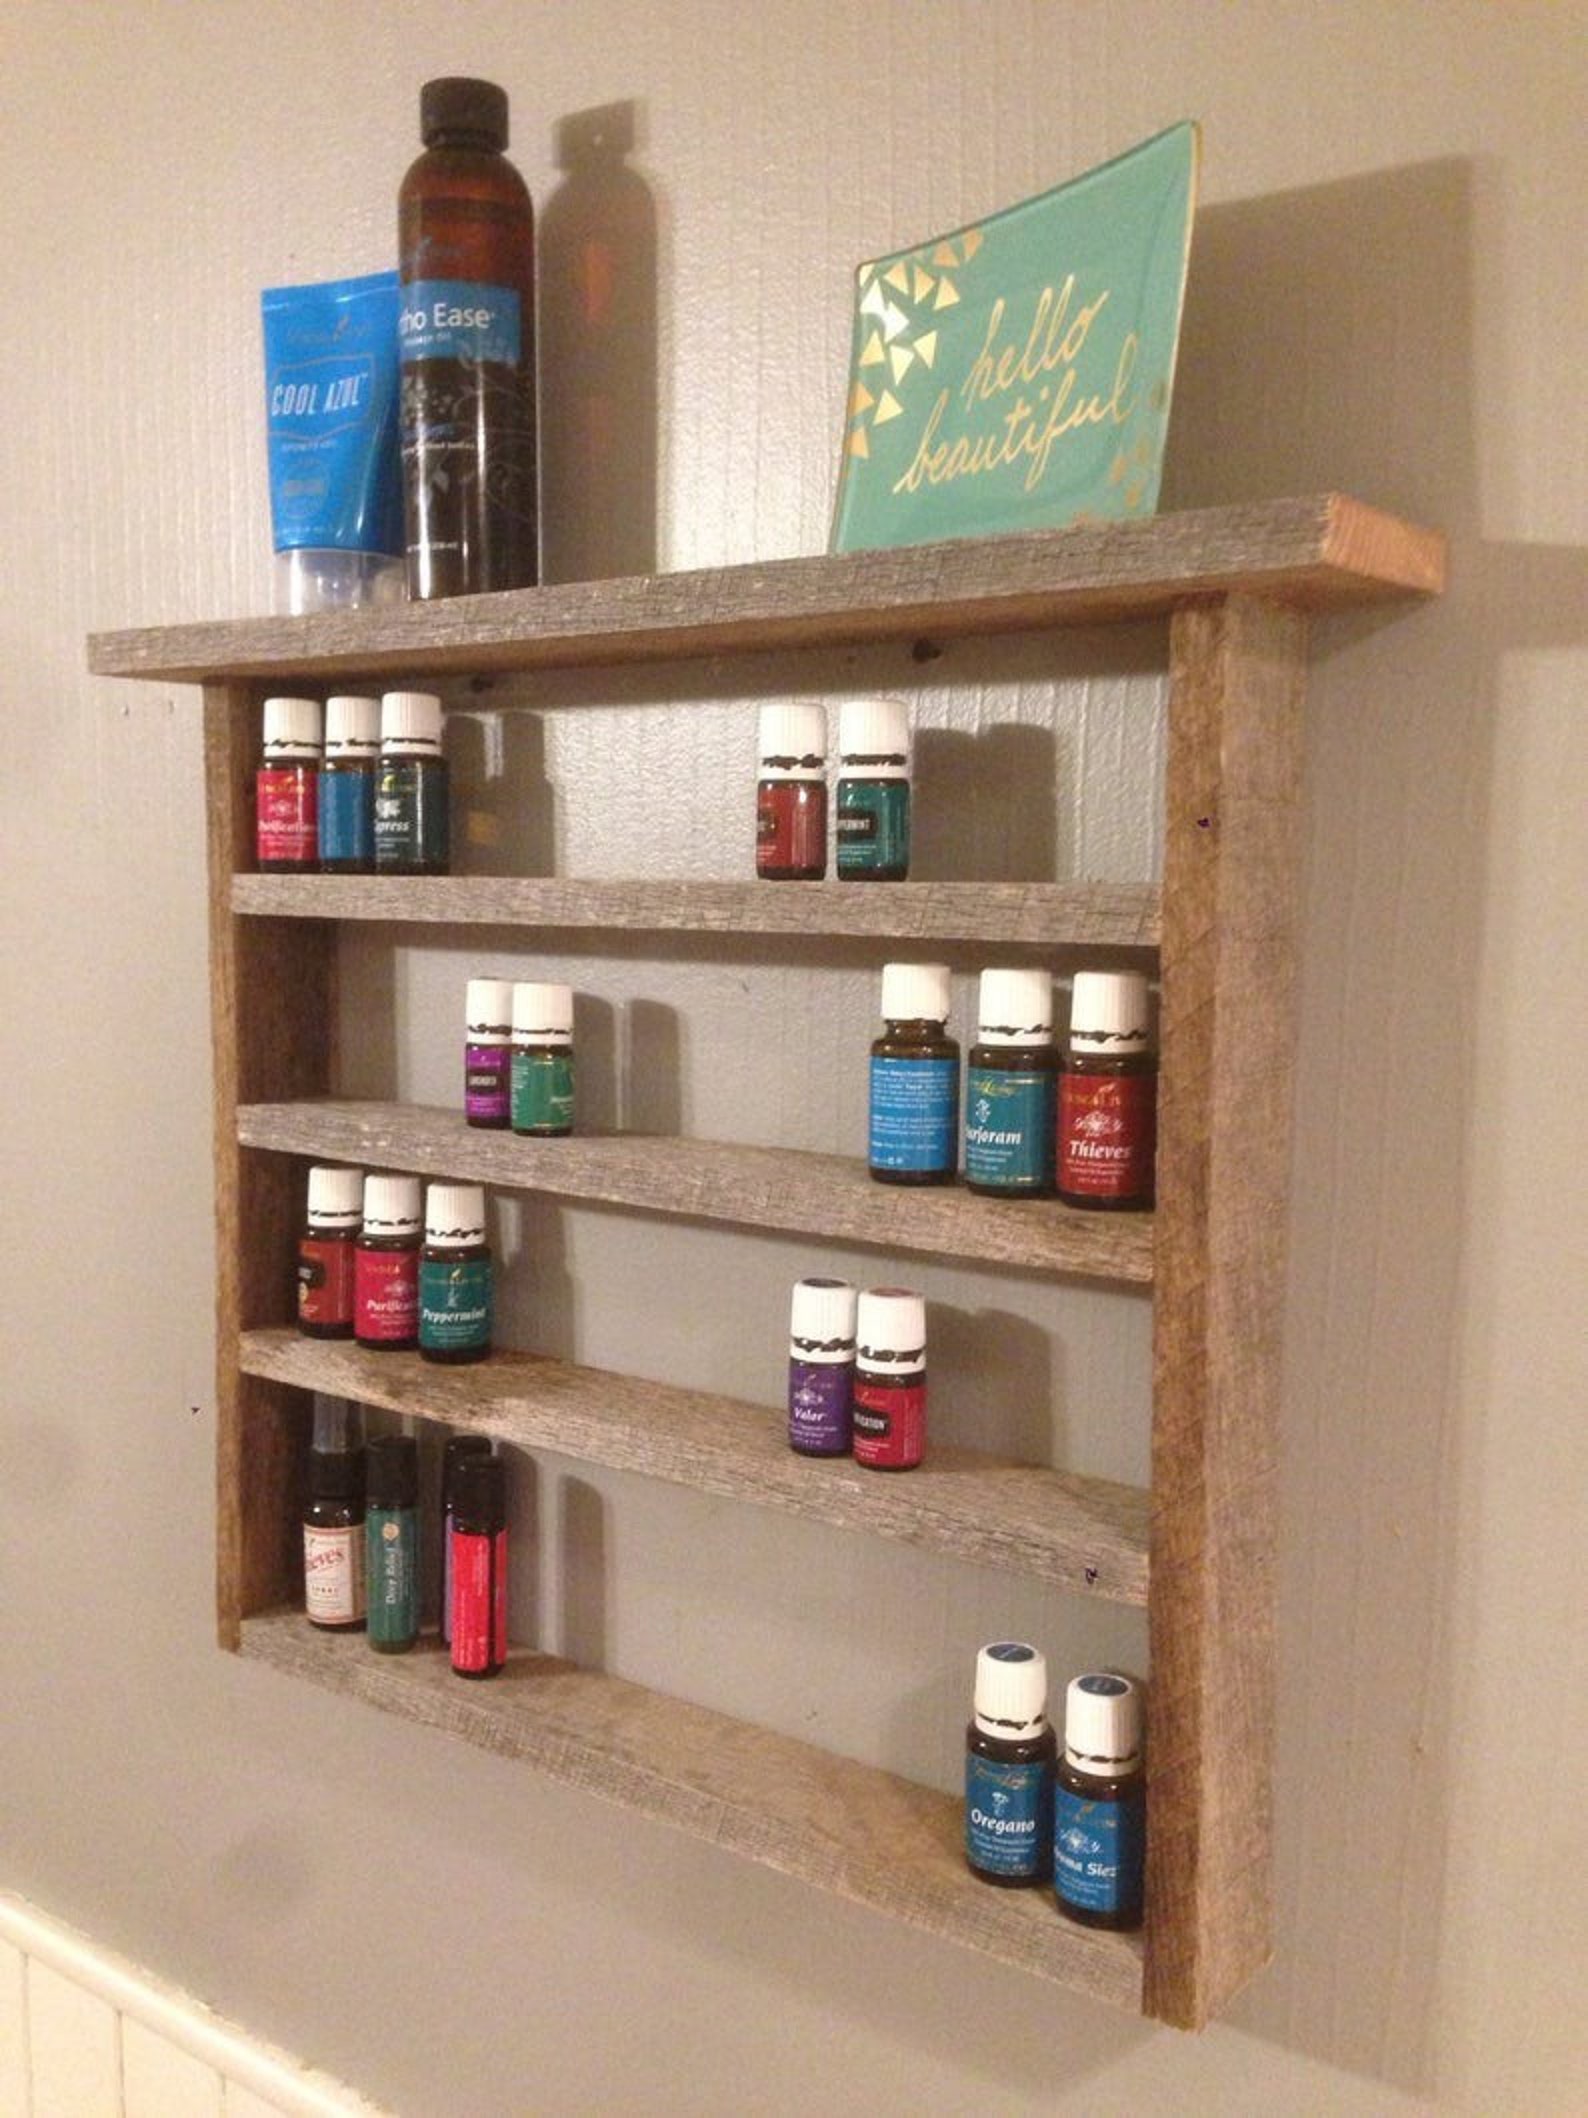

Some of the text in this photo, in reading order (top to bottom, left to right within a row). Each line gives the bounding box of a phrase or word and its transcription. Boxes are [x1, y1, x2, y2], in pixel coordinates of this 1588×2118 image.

[434, 303, 490, 329] Ease
[961, 273, 1110, 411] hello
[270, 383, 317, 416] COOL
[893, 333, 1136, 492] beautiful
[966, 1126, 1022, 1146] arjoram
[422, 1306, 487, 1325] Peppermint
[793, 1406, 827, 1422] Valor
[970, 1809, 1036, 1834] Oregano
